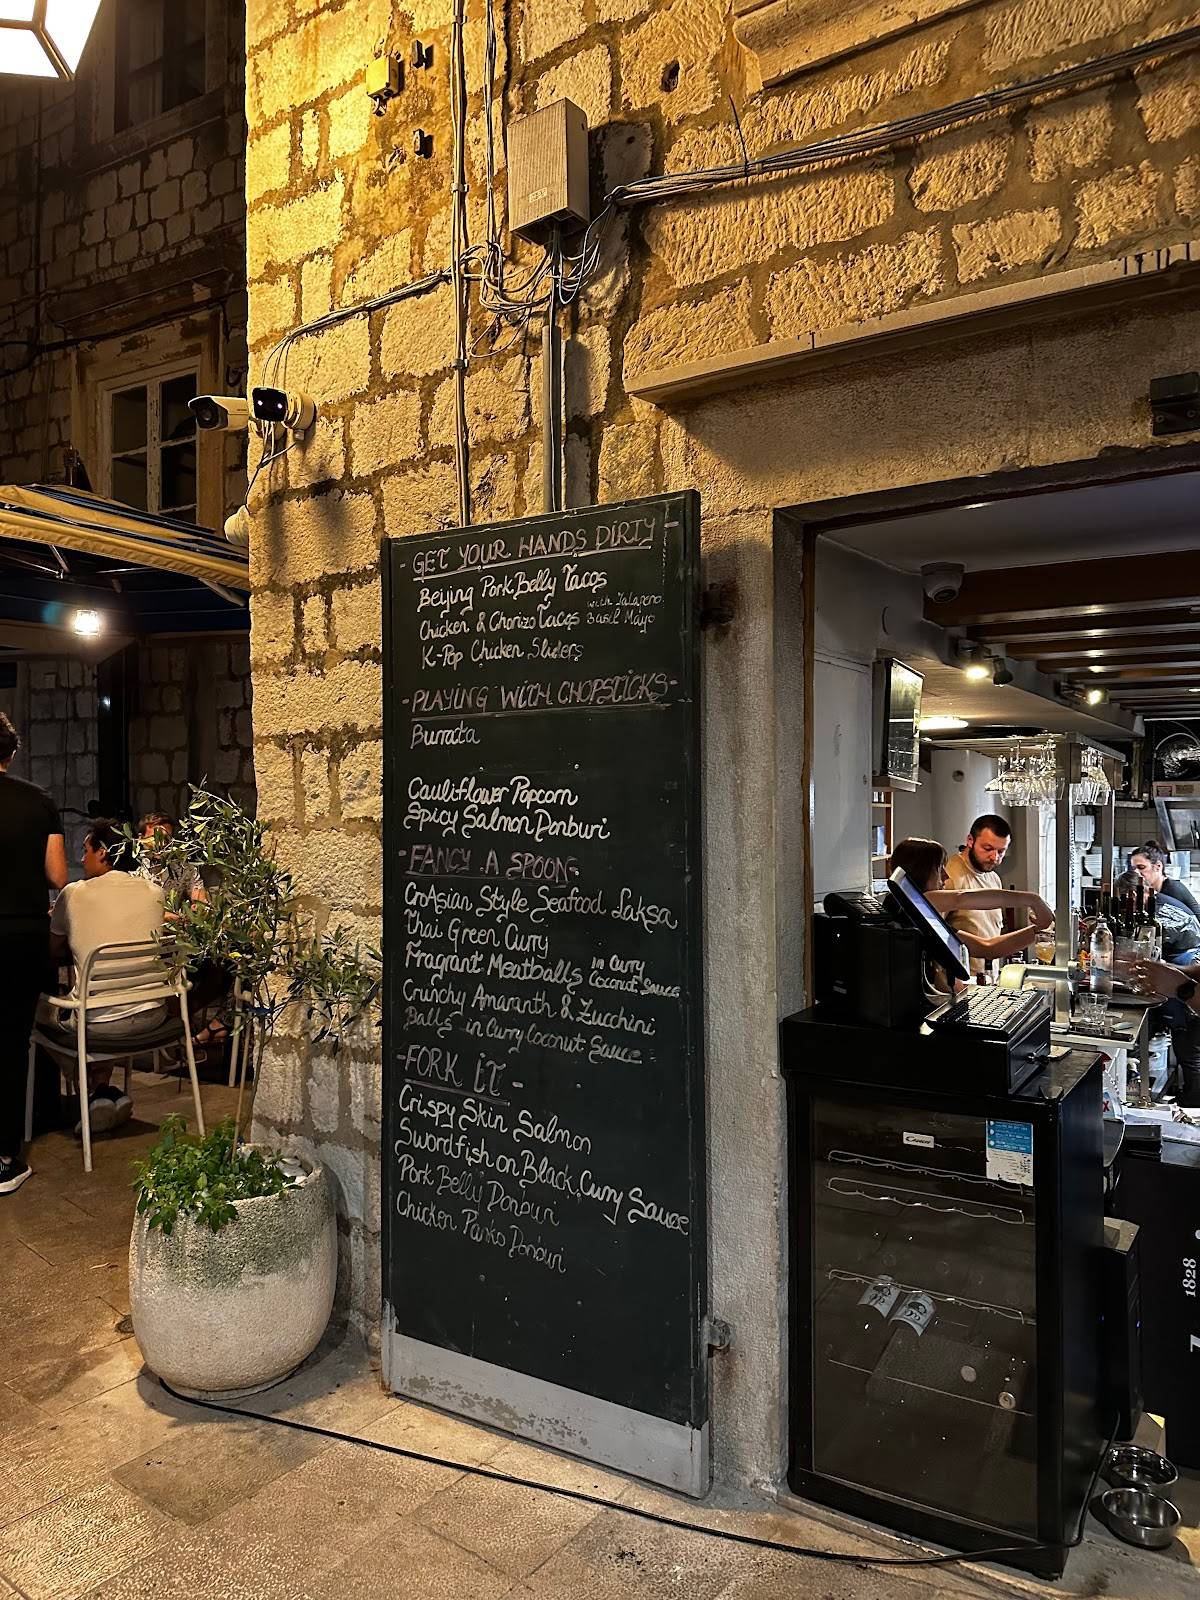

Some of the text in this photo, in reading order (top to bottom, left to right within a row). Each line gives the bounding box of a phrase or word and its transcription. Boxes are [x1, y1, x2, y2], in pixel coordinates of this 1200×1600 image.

[413, 547, 450, 575] GET
[458, 539, 511, 570] YOUR
[518, 529, 588, 559] HANDS
[595, 518, 656, 548] DIRTY
[480, 575, 515, 599] Pork
[513, 567, 558, 601] Belly
[561, 564, 607, 594] Tacos
[419, 601, 580, 641] Chicken & Chorizo Tacos
[624, 609, 656, 634] Mayo
[421, 639, 584, 670] K-Pop Chicken Sliders
[500, 679, 552, 709] WITH
[410, 720, 481, 749] Burrata
[408, 776, 578, 809] Cauliflower Popcorn
[403, 802, 610, 842] Spicy Salmon Donburi
[484, 849, 499, 875] A
[476, 885, 530, 923] Style
[530, 885, 606, 923] Seafood
[611, 888, 678, 933] Laksa
[404, 908, 549, 959] Thai Green Curry
[404, 940, 583, 995] Fragrant Meatballs
[588, 970, 638, 993] Coconut
[609, 955, 646, 982] Curry
[403, 978, 656, 1036] Crunchy Amaranth & Zucchini
[403, 1006, 642, 1064] Balls in Curry Coconut Sauce
[473, 1052, 506, 1096] IT
[399, 1084, 591, 1155] Crispy Skin Salmon
[395, 1117, 689, 1236] Swordfish on Black Curry Sauce
[399, 1154, 435, 1185] Pork
[437, 1165, 484, 1204] Belly
[396, 1191, 457, 1230] Chicken
[462, 1208, 506, 1247] Panko
[1182, 1257, 1197, 1297] 1828
